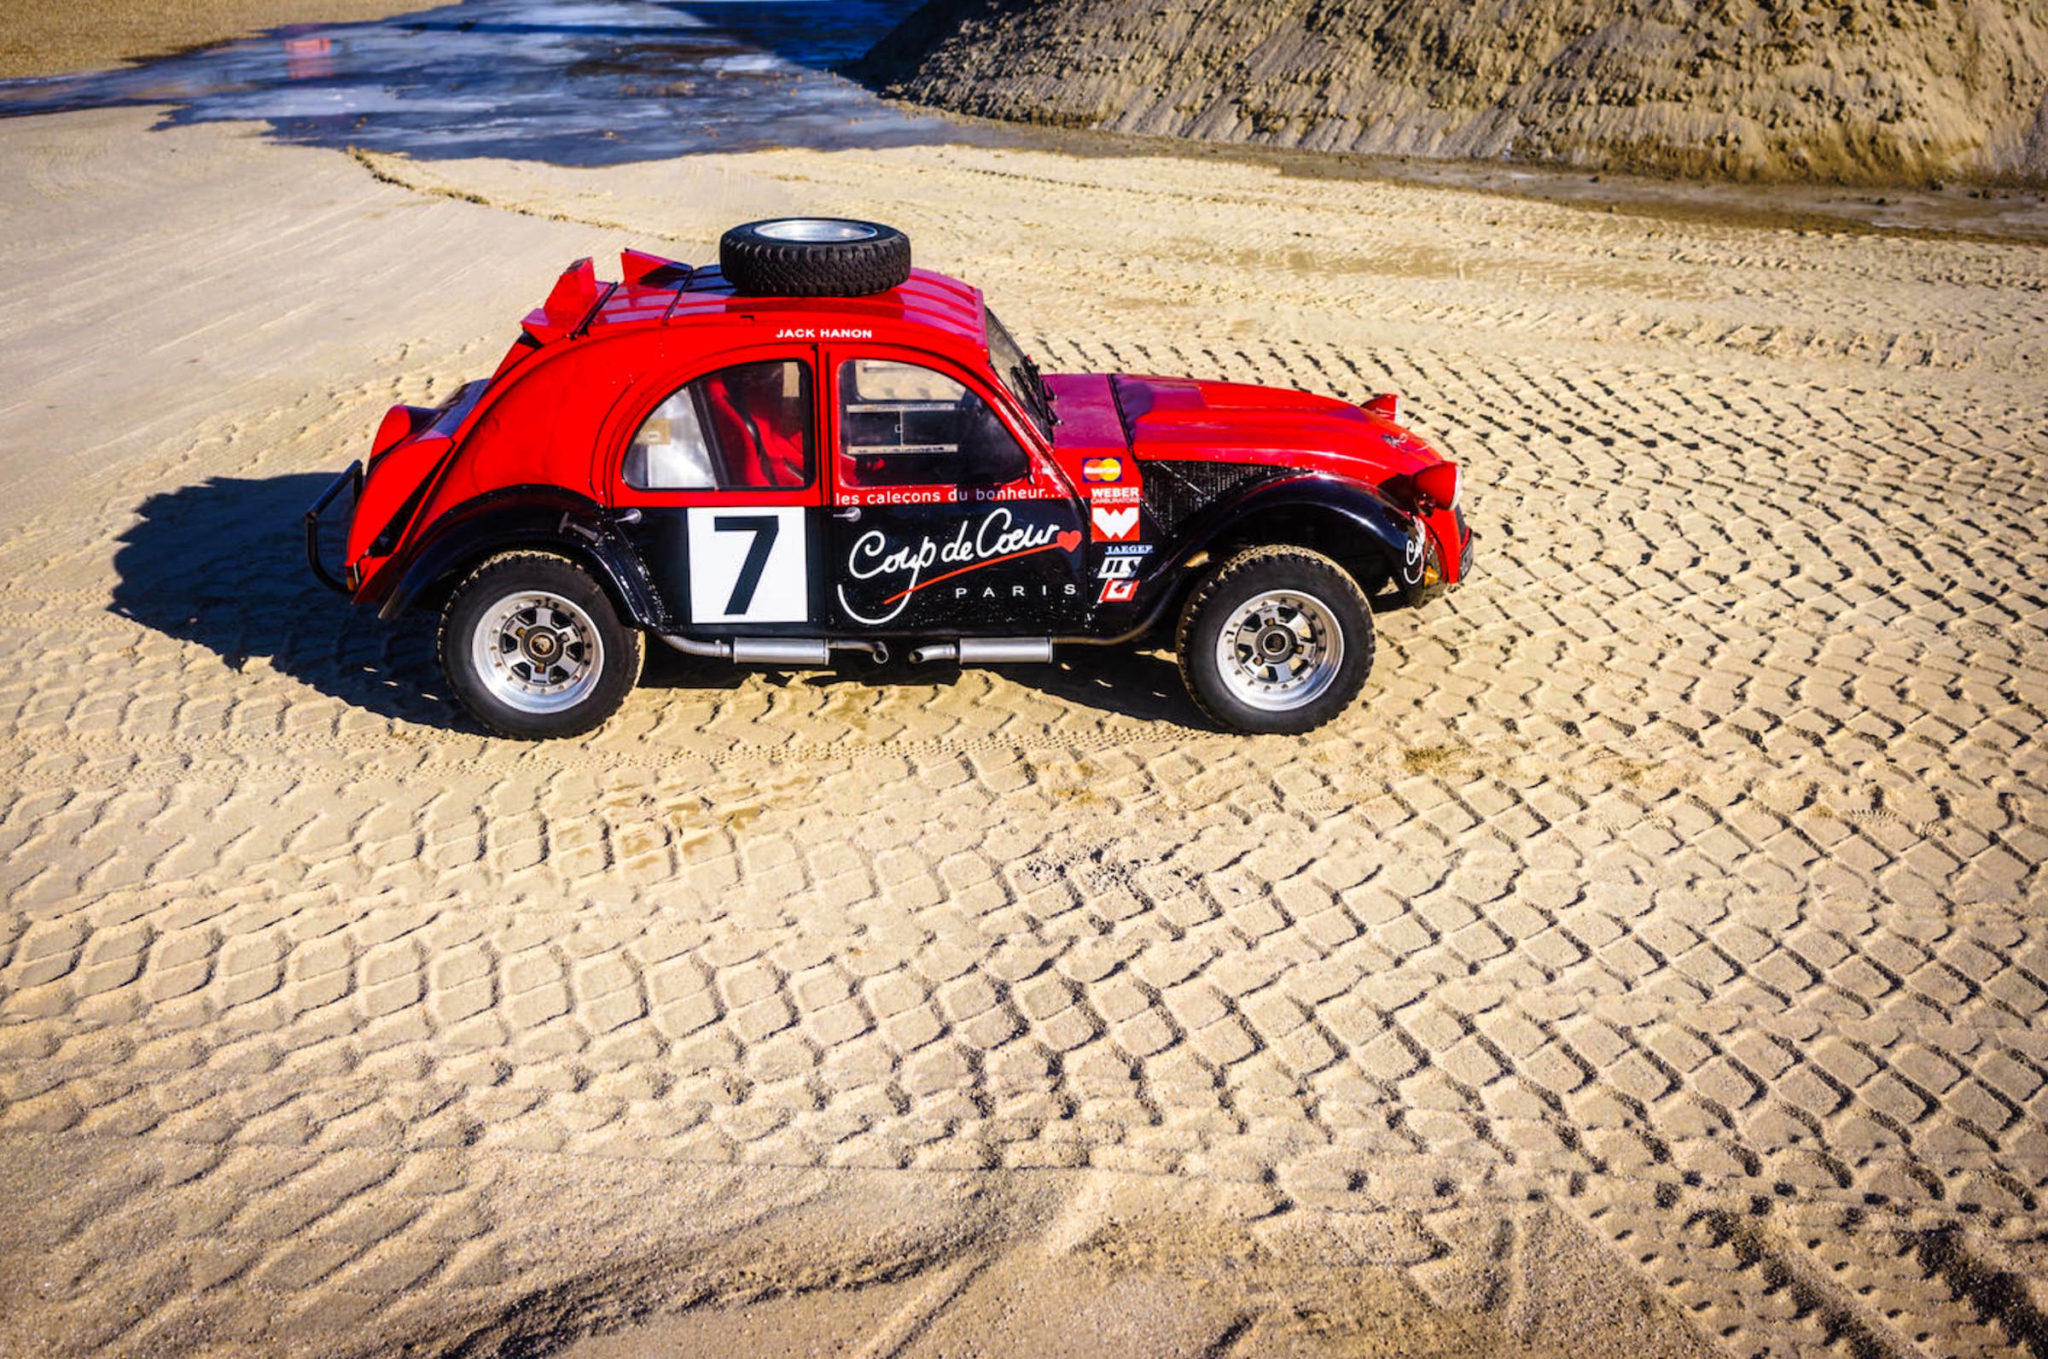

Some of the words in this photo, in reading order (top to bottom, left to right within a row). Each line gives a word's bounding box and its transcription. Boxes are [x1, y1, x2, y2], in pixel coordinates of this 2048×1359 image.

[776, 328, 815, 338] JACK
[820, 329, 872, 338] HANON
[835, 492, 860, 505] les
[866, 490, 941, 504] caleçons
[947, 488, 968, 502] du
[975, 486, 1061, 501] bonheur...
[1090, 487, 1140, 498] WEBER
[714, 515, 779, 615] 7
[837, 530, 937, 625] Coup
[941, 520, 974, 563] de
[955, 583, 1076, 599] PARIS
